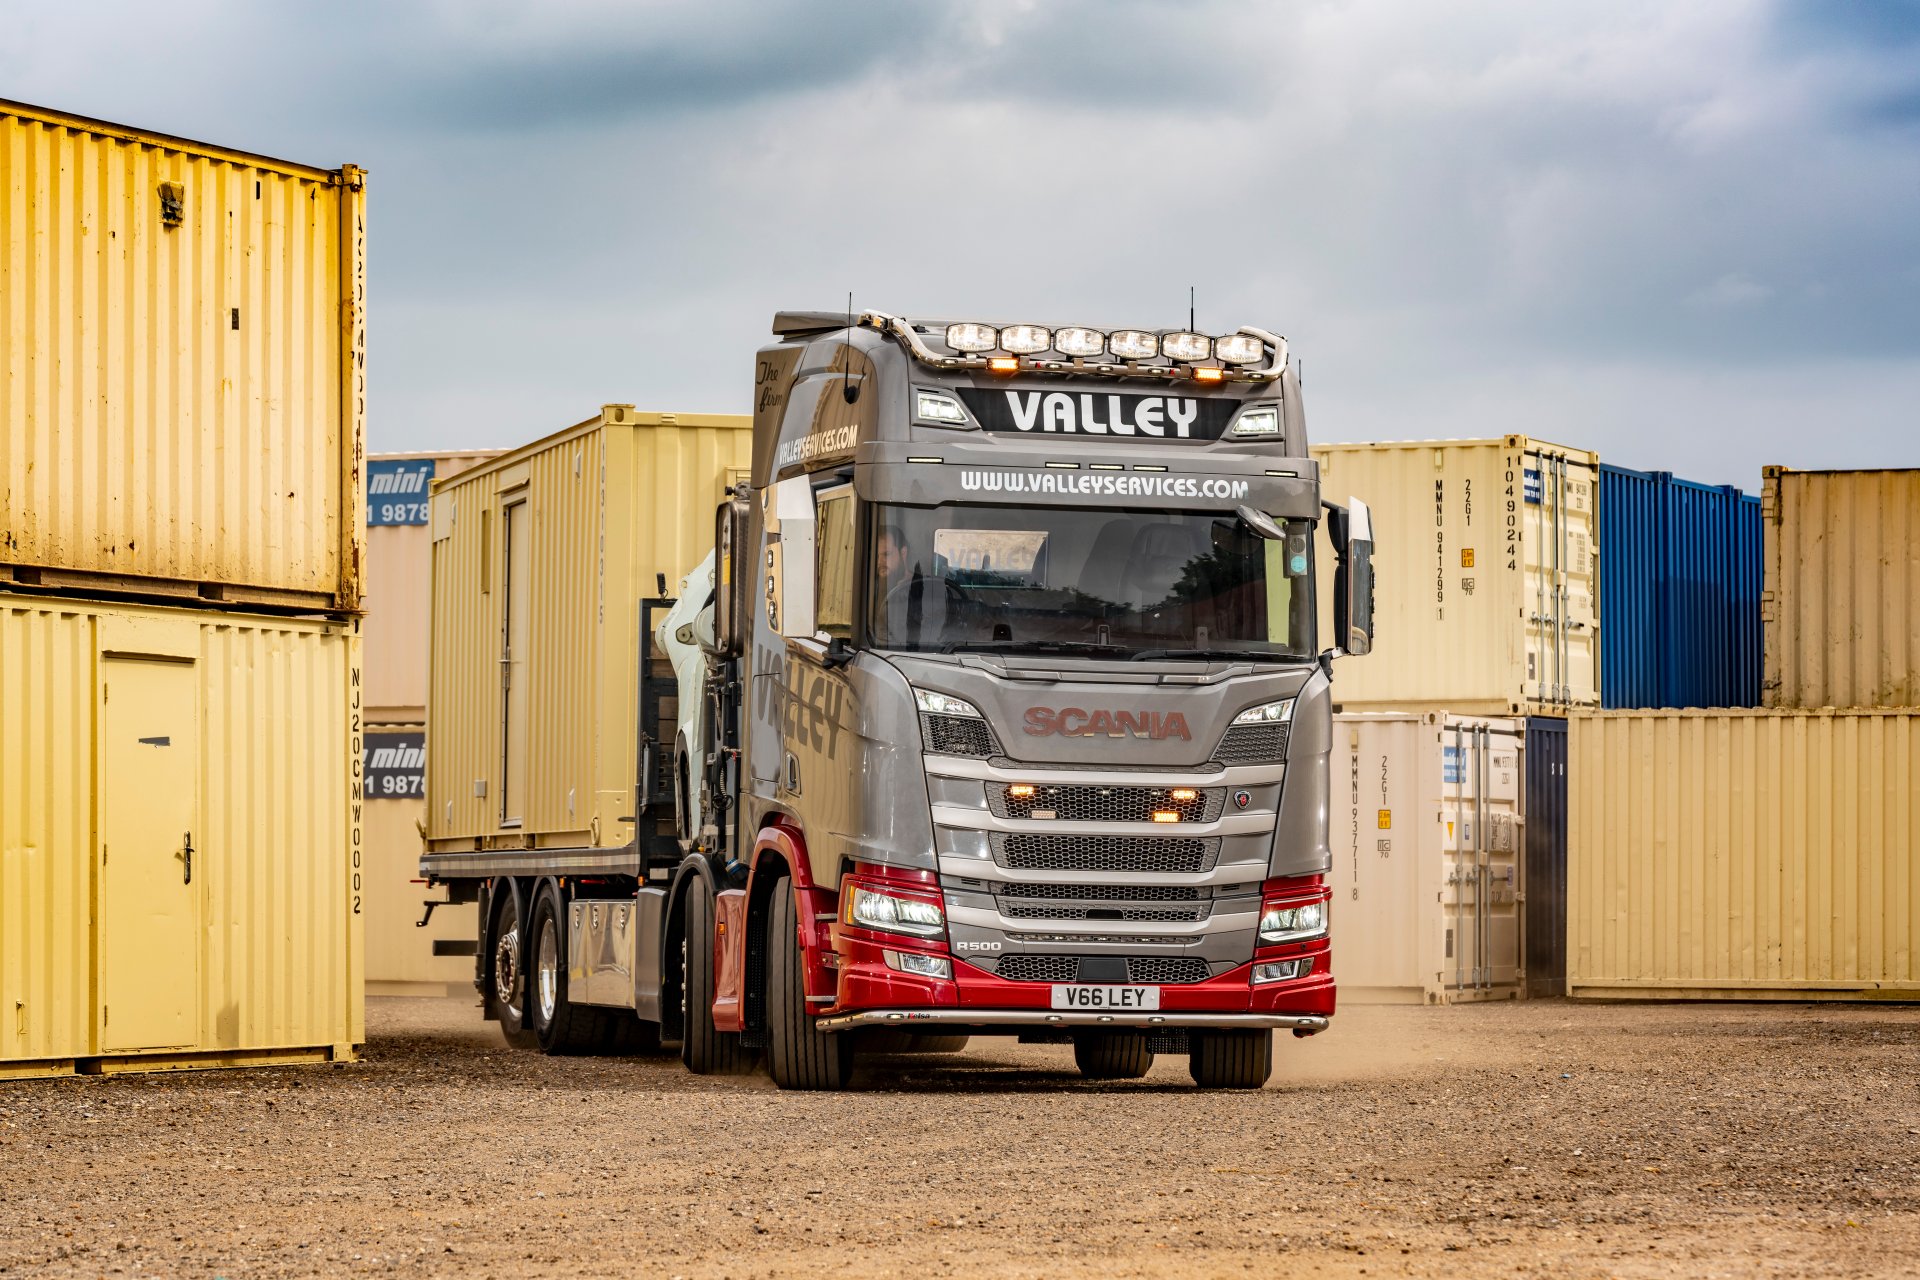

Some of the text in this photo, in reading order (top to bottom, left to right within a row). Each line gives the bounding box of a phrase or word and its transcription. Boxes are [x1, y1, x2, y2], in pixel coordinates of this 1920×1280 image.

[757, 362, 779, 384] The
[759, 387, 783, 413] firm
[1005, 391, 1198, 438] VALLEY
[780, 425, 859, 465] VALLEYSERVICES.COM
[369, 467, 427, 494] mini
[961, 471, 1249, 499] WWW.VALLEYSERVICES.COM
[382, 503, 428, 522] 9878
[1505, 456, 1516, 571] 10490244
[758, 643, 843, 760] VALLEY
[1023, 706, 1192, 741] SCANIA
[370, 743, 425, 768] mini
[352, 668, 361, 914] NJ20CMW0002
[957, 942, 1001, 950] R500
[1066, 988, 1145, 1007] V66 LEY
